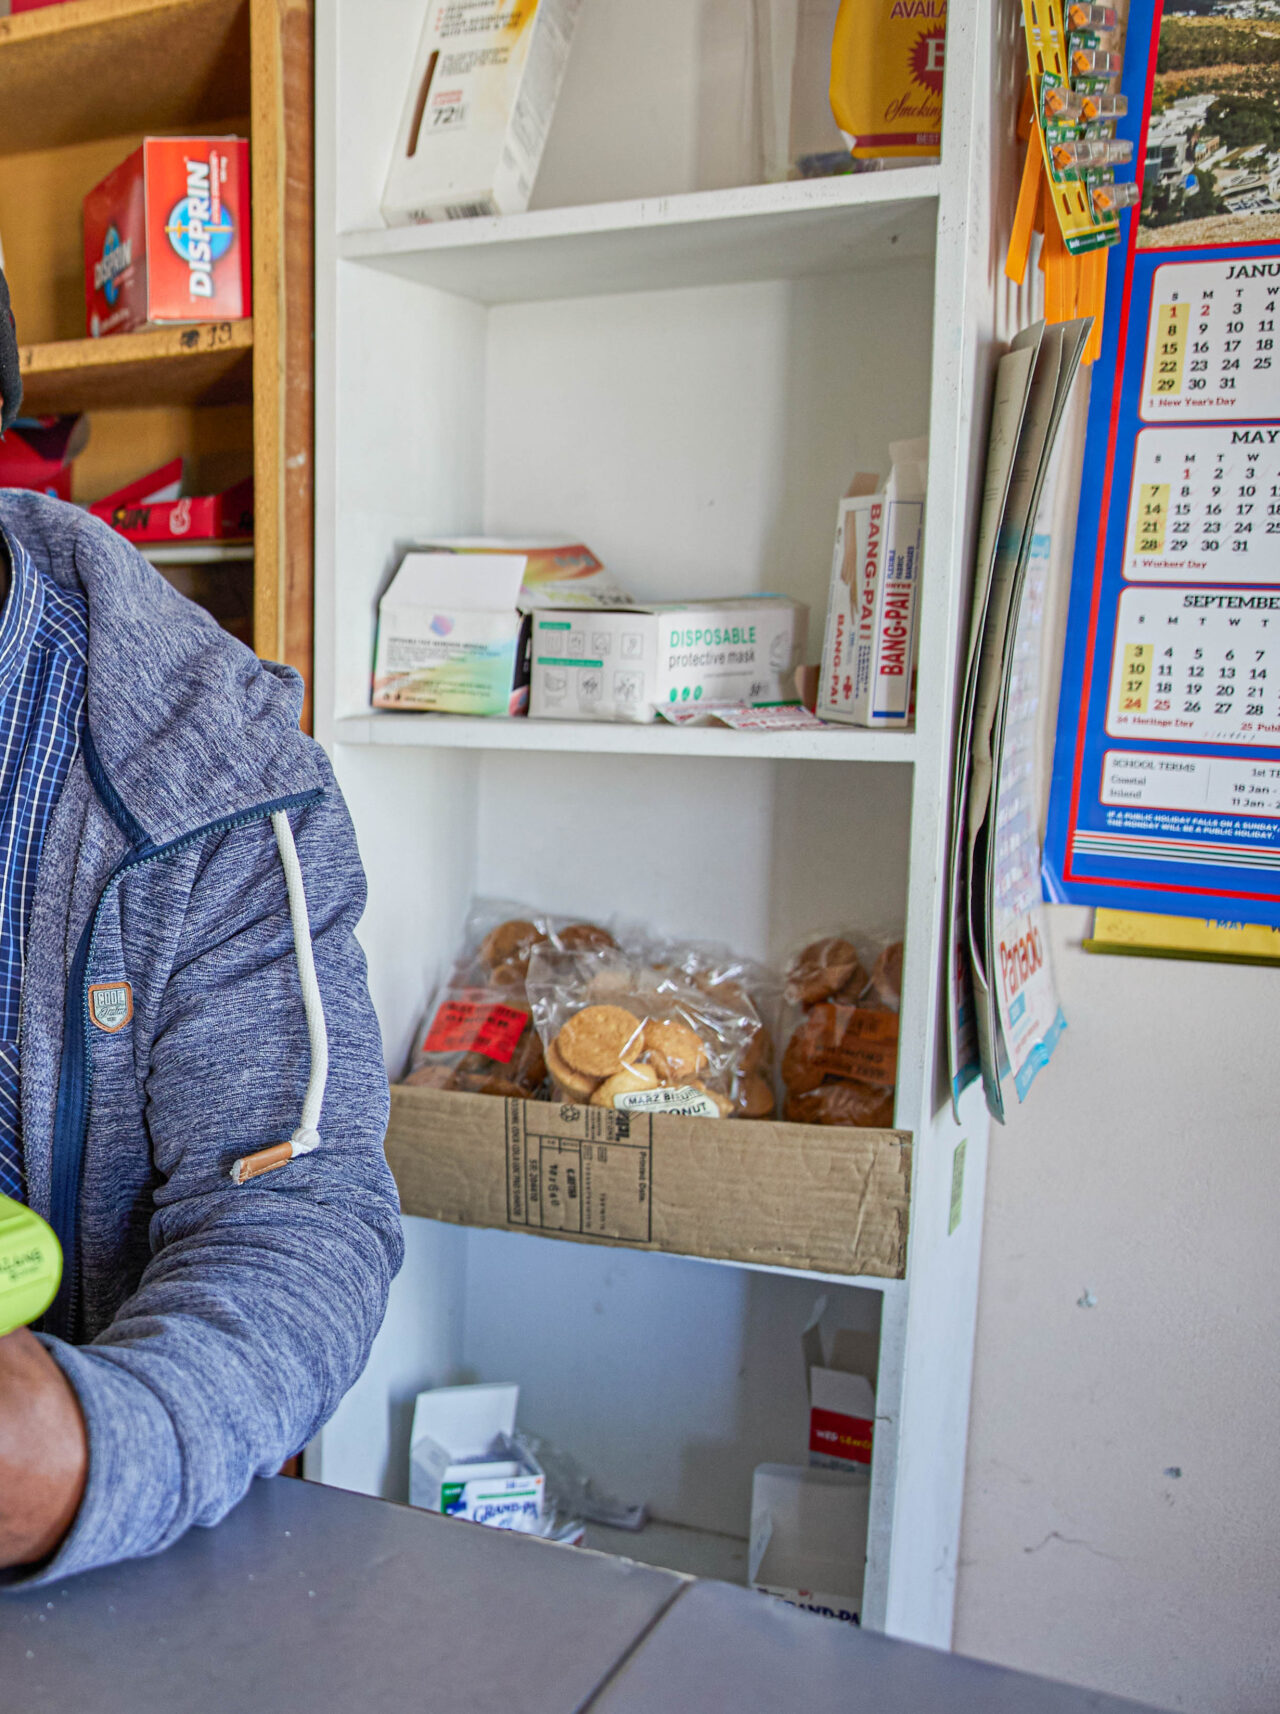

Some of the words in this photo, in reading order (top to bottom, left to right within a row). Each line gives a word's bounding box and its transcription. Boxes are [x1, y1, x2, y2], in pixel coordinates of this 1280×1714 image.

[186, 159, 213, 297] DISPRIN
[1202, 291, 1214, 299] M
[1236, 289, 1244, 297] T
[1267, 287, 1280, 296] W
[1170, 306, 1177, 317] 1
[1200, 305, 1210, 316] 2
[1232, 303, 1242, 314] 3
[1265, 301, 1275, 312] 4
[1168, 325, 1177, 336] 8
[1199, 324, 1208, 335] 9
[1226, 322, 1244, 334] 10
[1258, 320, 1274, 332] 11
[1162, 343, 1178, 355] 15
[1193, 342, 1209, 354] 16
[1224, 340, 1241, 352] 17
[1256, 339, 1274, 351] 18
[1159, 361, 1177, 373] 22
[1190, 360, 1208, 372] 23
[1221, 359, 1240, 370] 24
[1253, 357, 1271, 369] 25
[1157, 379, 1175, 391] 29
[1188, 379, 1206, 390] 30
[1219, 378, 1236, 389] 31
[1216, 397, 1236, 407] Day
[1231, 430, 1280, 444] MAY
[1184, 454, 1195, 463] M
[1216, 454, 1224, 462] T
[1247, 453, 1260, 462] W
[1184, 469, 1190, 480] 1
[1214, 468, 1223, 480] 2
[1245, 468, 1255, 479] 3
[1150, 486, 1160, 497] 7
[1181, 486, 1190, 497] 8
[1212, 486, 1221, 497] 9
[1238, 486, 1256, 497] 10
[1144, 503, 1161, 515] 14
[1175, 503, 1191, 515] 15
[1205, 503, 1222, 515] 16
[1236, 504, 1254, 515] 17
[1142, 522, 1158, 533] 21
[1172, 522, 1190, 533] 22
[1202, 522, 1221, 533] 23
[1234, 522, 1253, 534] 24
[1140, 539, 1158, 551] 28
[1170, 540, 1188, 551] 29
[1201, 540, 1220, 551] 30
[1232, 540, 1248, 551] 31
[860, 504, 882, 630] BANG-PAI
[1167, 616, 1179, 624] M
[1199, 618, 1207, 626] T
[1229, 618, 1241, 626] W
[1262, 619, 1269, 627] T
[670, 626, 756, 648] DISPOSABLE
[880, 592, 910, 676] BANG-PAI
[669, 652, 725, 670] protective
[728, 651, 756, 663] mask
[830, 614, 844, 704] BANG-PAI
[1134, 645, 1143, 657] 3
[1164, 647, 1173, 658] 4
[1194, 648, 1203, 659] 5
[1225, 649, 1234, 661] 6
[1255, 650, 1265, 662] 7
[1128, 664, 1145, 675] 10
[1158, 665, 1172, 676] 11
[1188, 666, 1205, 678] 12
[1219, 667, 1236, 679] 13
[1249, 669, 1267, 680] 14
[1126, 681, 1142, 692] 17
[1156, 682, 1172, 694] 18
[1186, 683, 1202, 695] 19
[1216, 685, 1235, 696] 20
[1247, 687, 1263, 698] 21
[1123, 698, 1142, 709] 24
[1153, 699, 1170, 711] 25
[1183, 701, 1201, 713] 26
[1214, 702, 1232, 714] 27
[1245, 704, 1264, 716] 28
[1220, 820, 1233, 828] ON
[628, 1094, 660, 1105] MARZ
